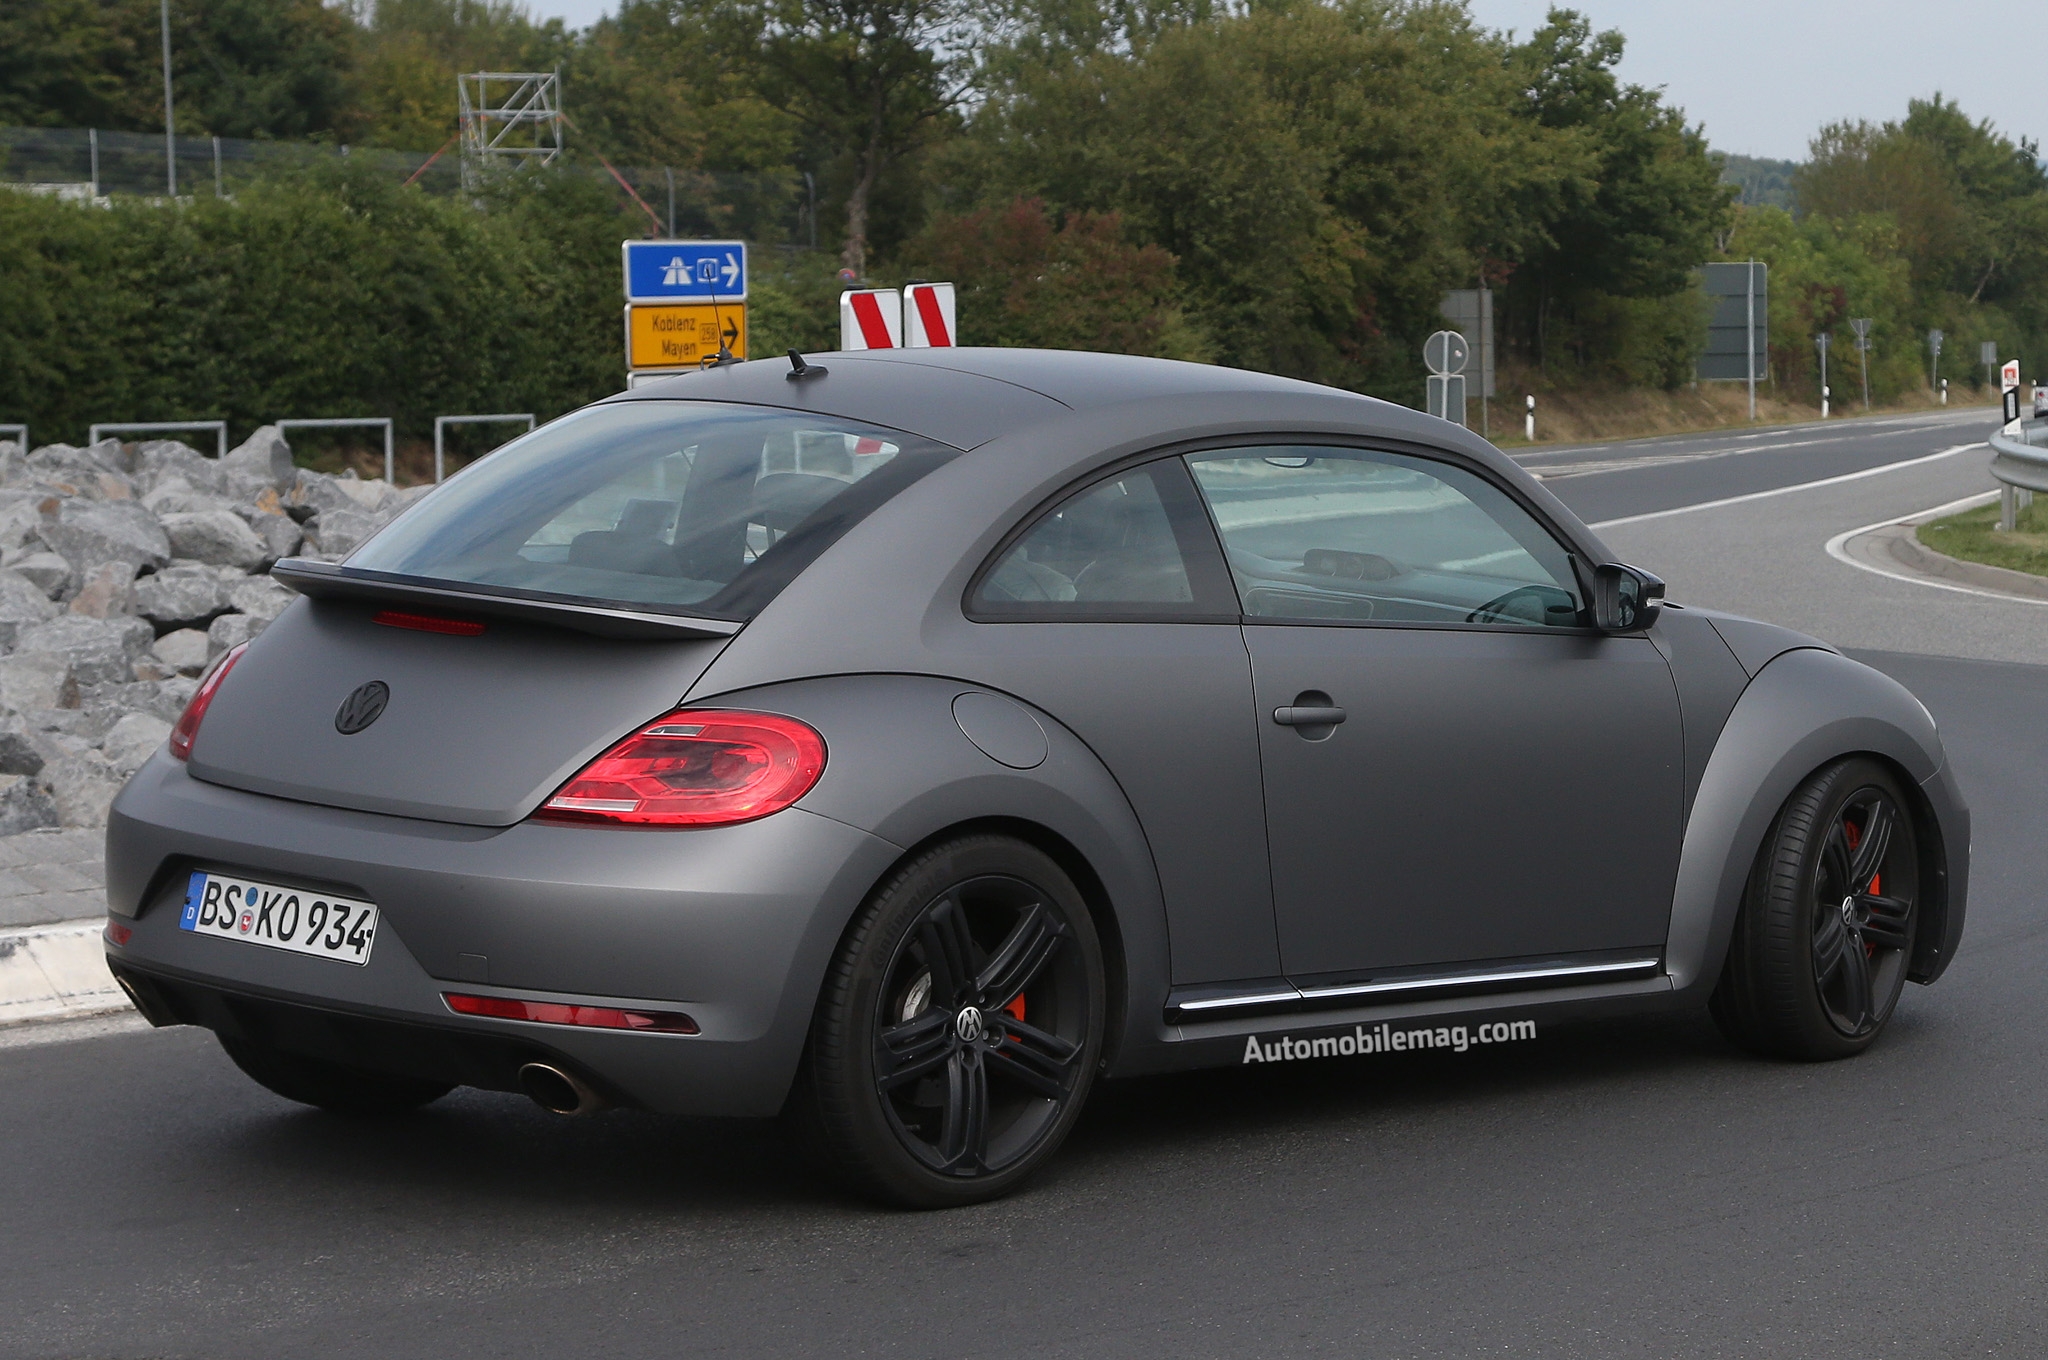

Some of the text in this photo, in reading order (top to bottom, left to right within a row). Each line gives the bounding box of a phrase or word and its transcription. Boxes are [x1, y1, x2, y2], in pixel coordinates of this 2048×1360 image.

[652, 315, 696, 332] Koblenz
[701, 328, 717, 341] 258
[661, 340, 697, 360] Mayen
[187, 907, 195, 920] D
[199, 881, 370, 955] BS KO 934
[957, 1006, 982, 1042] VW
